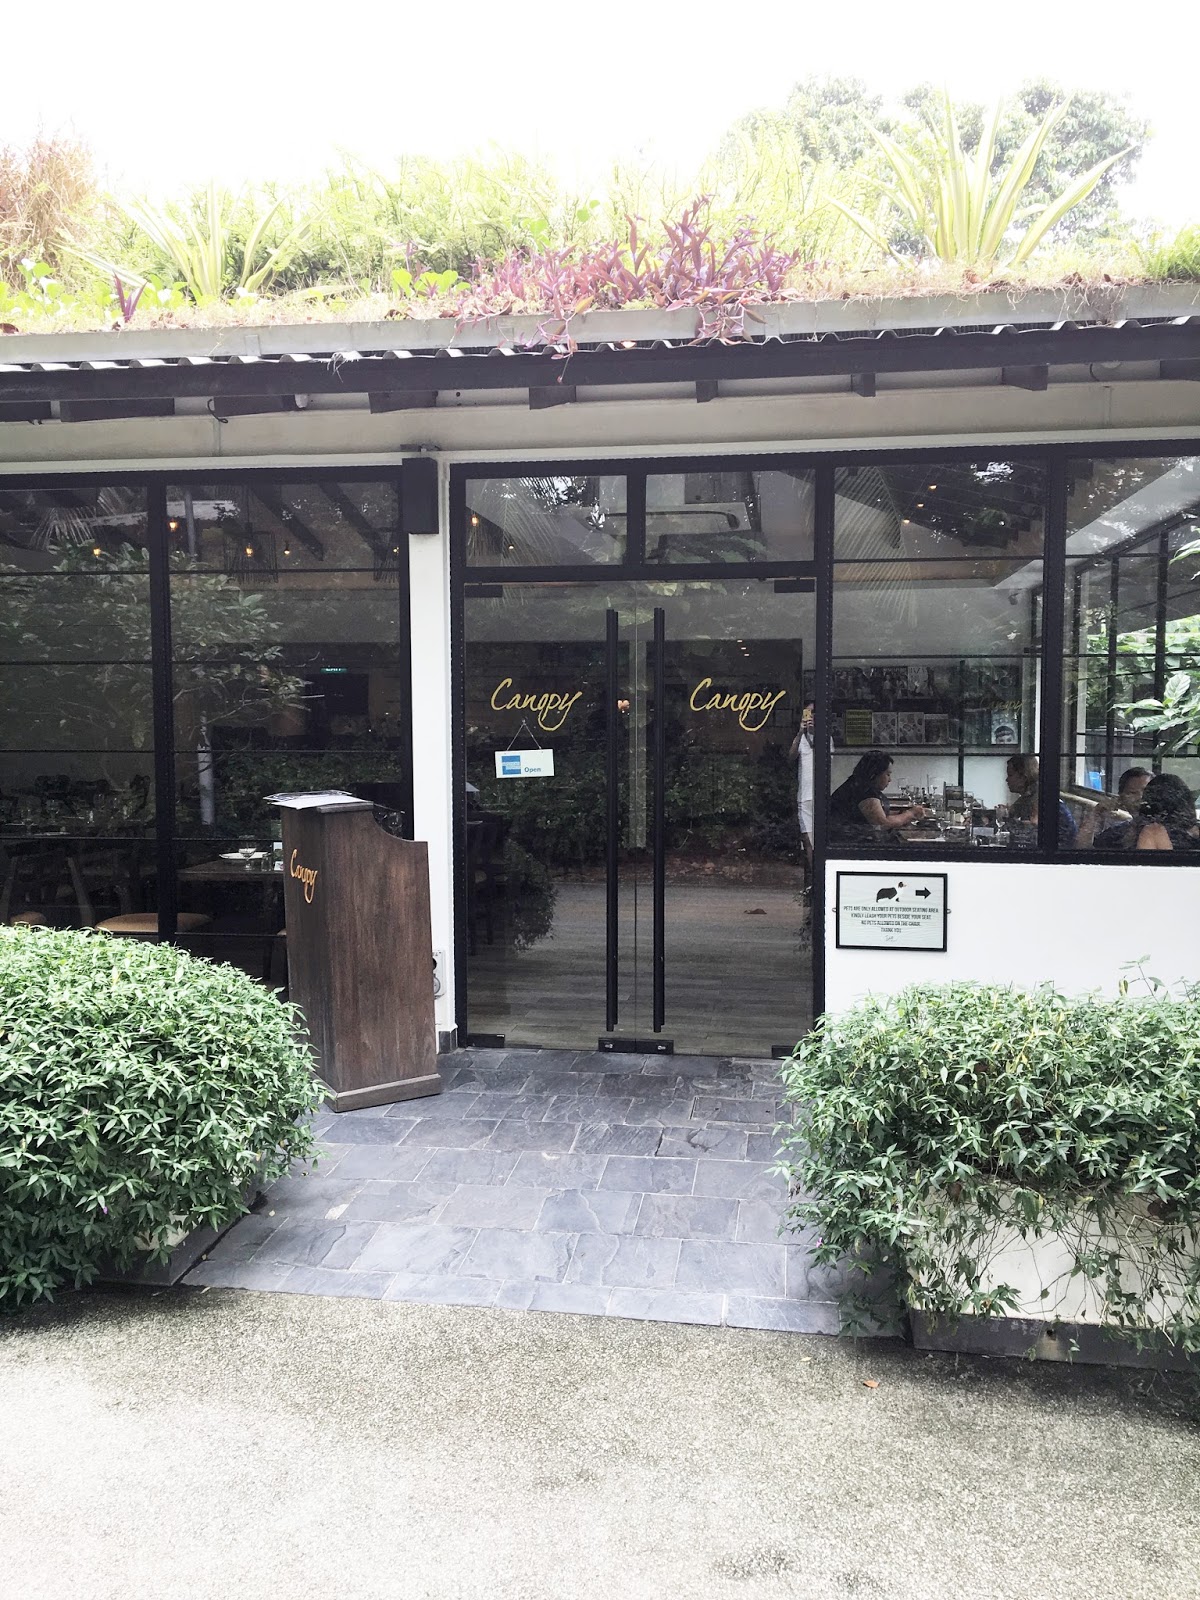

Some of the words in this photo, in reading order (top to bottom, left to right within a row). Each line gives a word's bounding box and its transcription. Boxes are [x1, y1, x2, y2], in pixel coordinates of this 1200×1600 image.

[490, 677, 583, 732] Canopy
[689, 677, 786, 732] Canopy
[290, 849, 318, 904] Canopy
